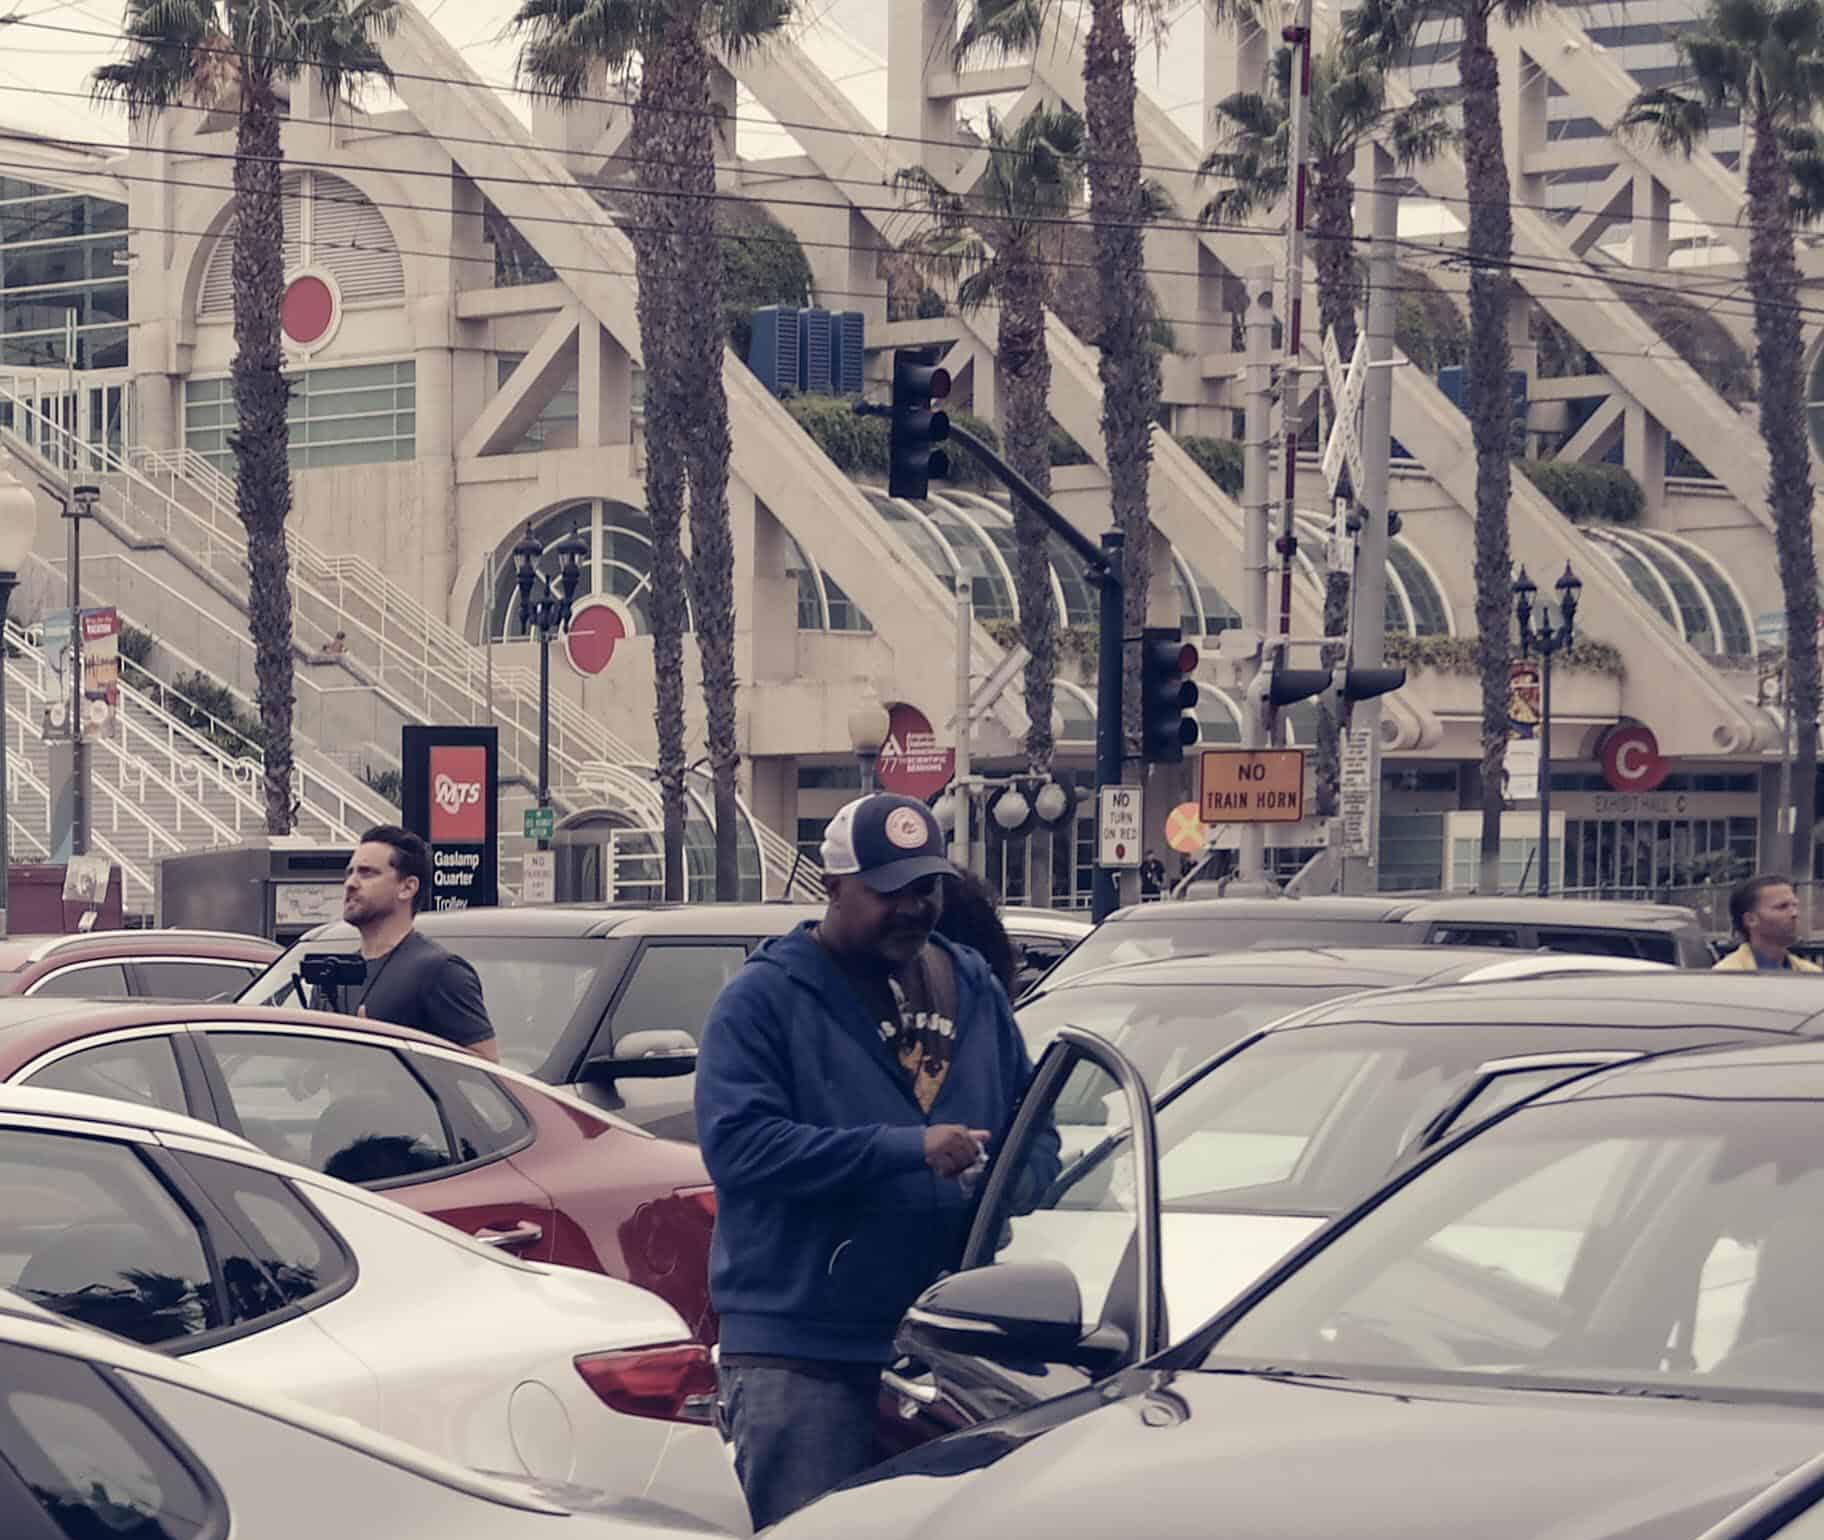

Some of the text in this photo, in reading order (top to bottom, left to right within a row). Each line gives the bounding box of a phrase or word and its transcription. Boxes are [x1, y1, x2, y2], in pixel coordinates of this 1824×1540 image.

[1616, 741, 1650, 779] C
[1237, 764, 1266, 781] NO
[436, 782, 481, 804] MTS
[1112, 793, 1130, 808] NO
[1208, 791, 1297, 809] TRAIN HORN
[1110, 812, 1134, 825] TURN
[1104, 827, 1137, 841] ON RED
[434, 851, 480, 870] Gaslamp
[434, 870, 474, 887] Quarter
